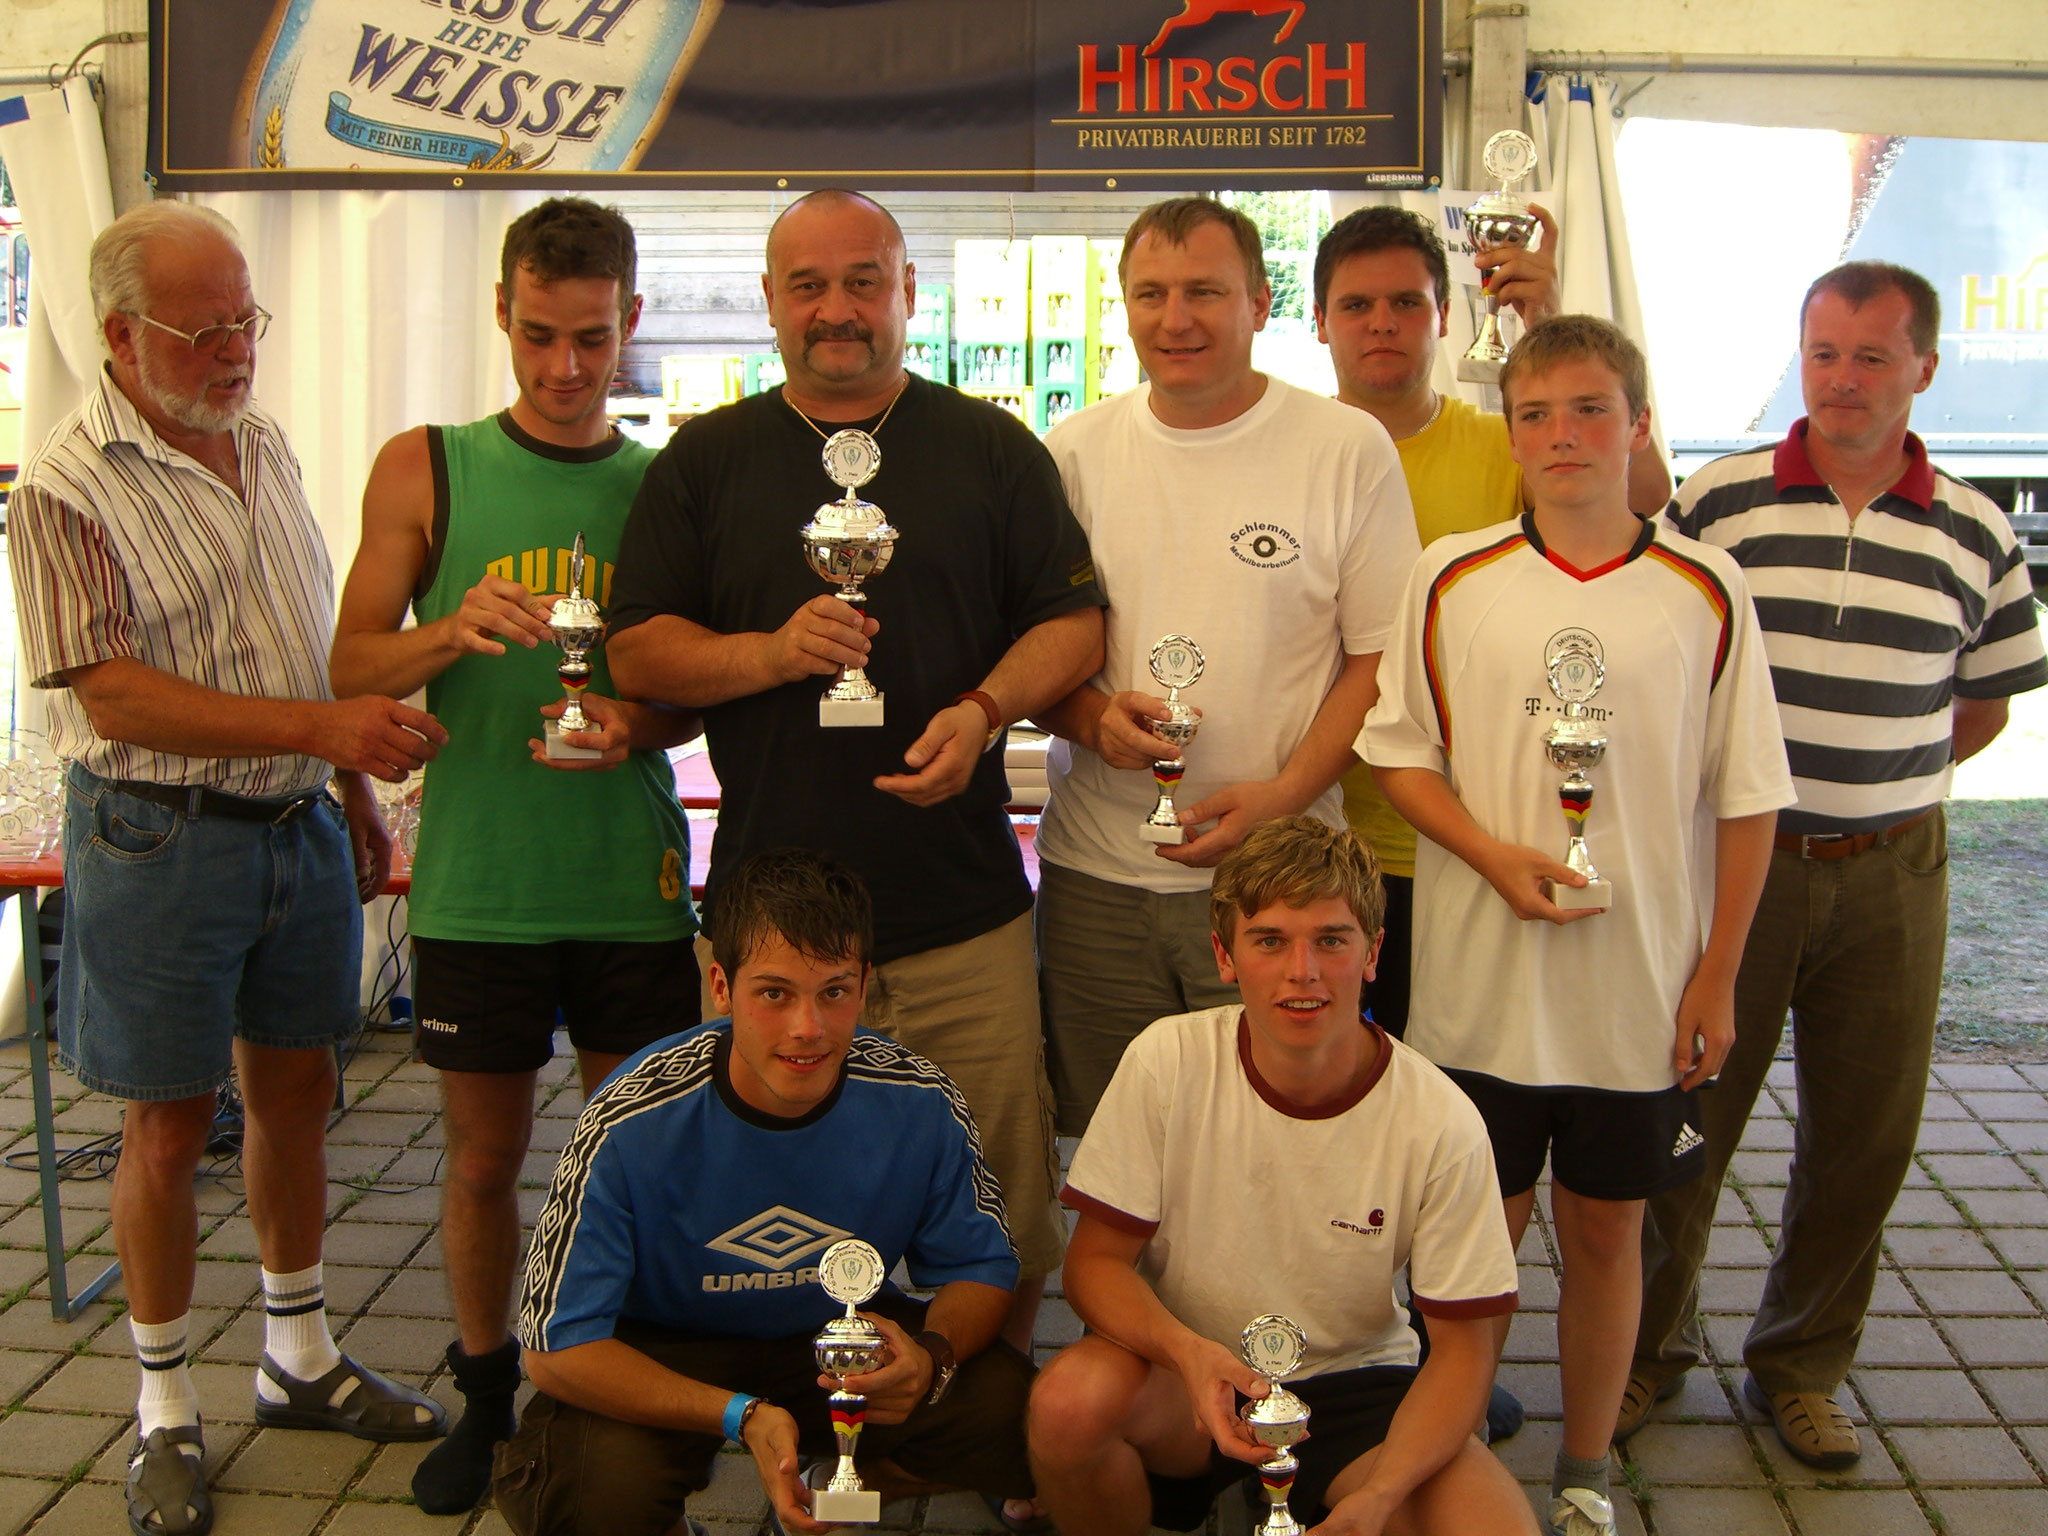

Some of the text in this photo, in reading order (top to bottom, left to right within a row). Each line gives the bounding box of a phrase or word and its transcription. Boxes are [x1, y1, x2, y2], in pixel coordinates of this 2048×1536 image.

[434, 18, 531, 62] HEFE
[349, 23, 627, 142] WEISSE
[1077, 42, 1367, 113] HIRSCH
[338, 118, 469, 157] MIT FEINER HEFE
[1077, 126, 1367, 148] PRIVATBRAUEREI SEIT 1782
[1230, 522, 1301, 550] Schlemmer
[1229, 545, 1300, 569] Metallbearbeitung
[1556, 635, 1594, 649] DEUTSCHER
[422, 1018, 458, 1034] erima
[1672, 1133, 1704, 1157] adidas
[1331, 1219, 1383, 1235] carhartt
[702, 1266, 820, 1293] UMBR
